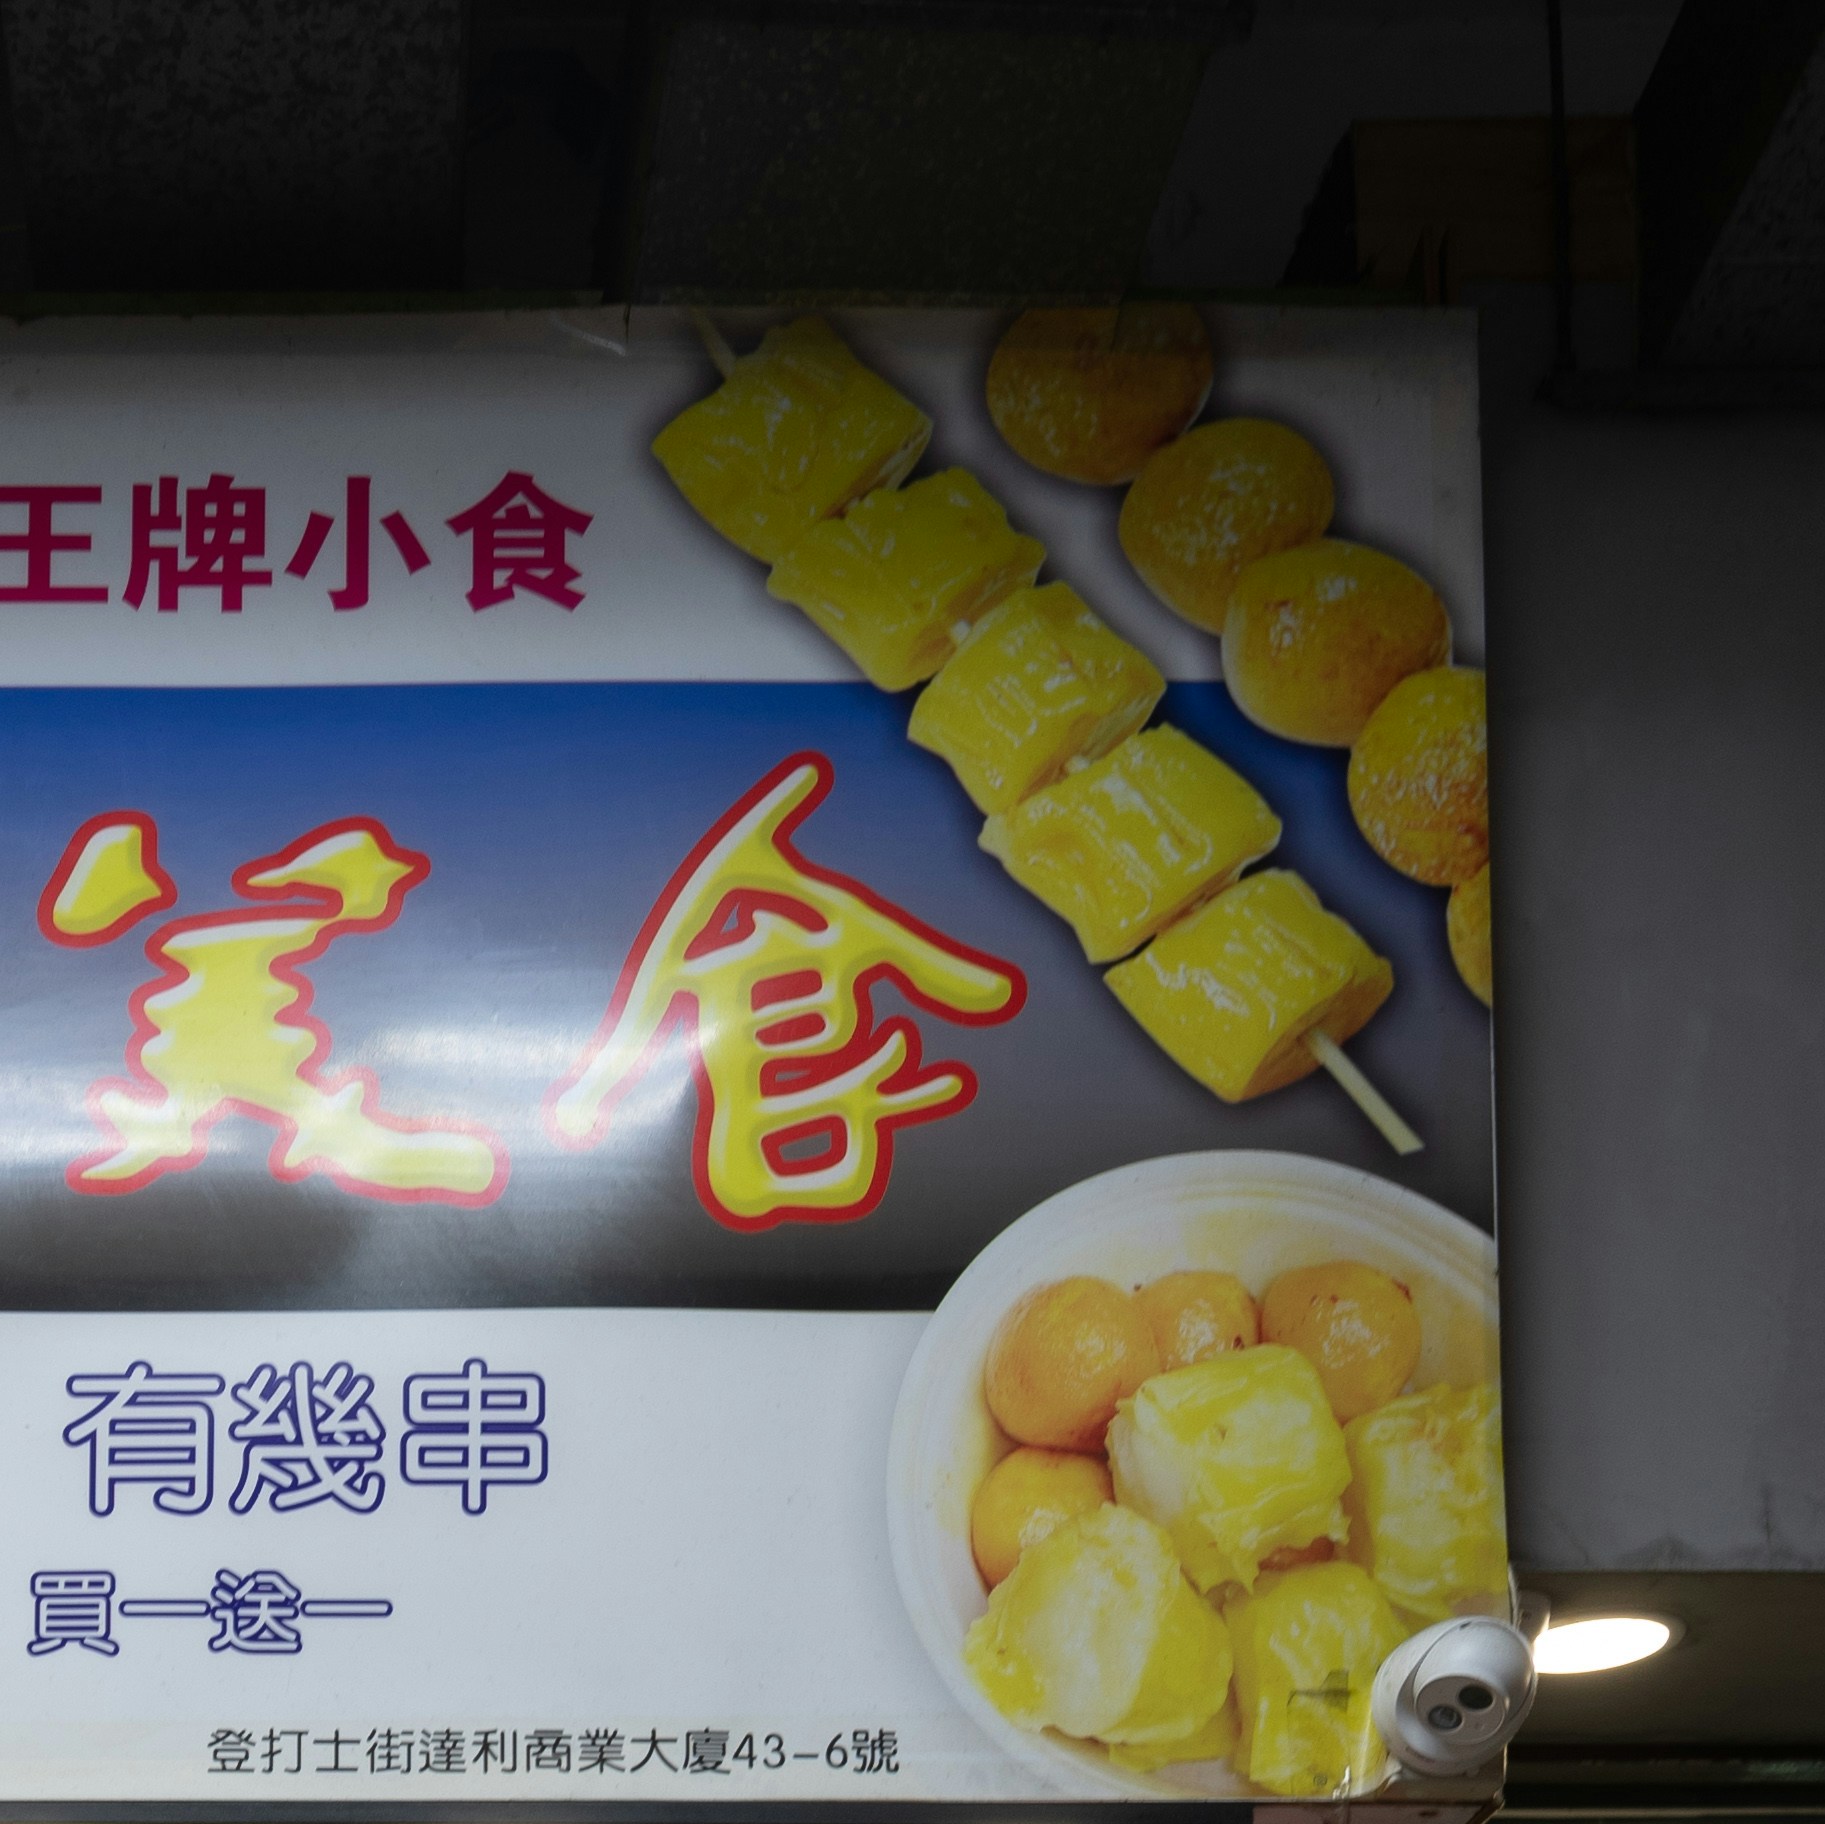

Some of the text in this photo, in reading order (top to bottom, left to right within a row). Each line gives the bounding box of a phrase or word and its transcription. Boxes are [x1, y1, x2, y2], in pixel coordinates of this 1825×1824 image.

[63, 1359, 549, 1517] 有幾串
[28, 1570, 393, 1656] 買一送一
